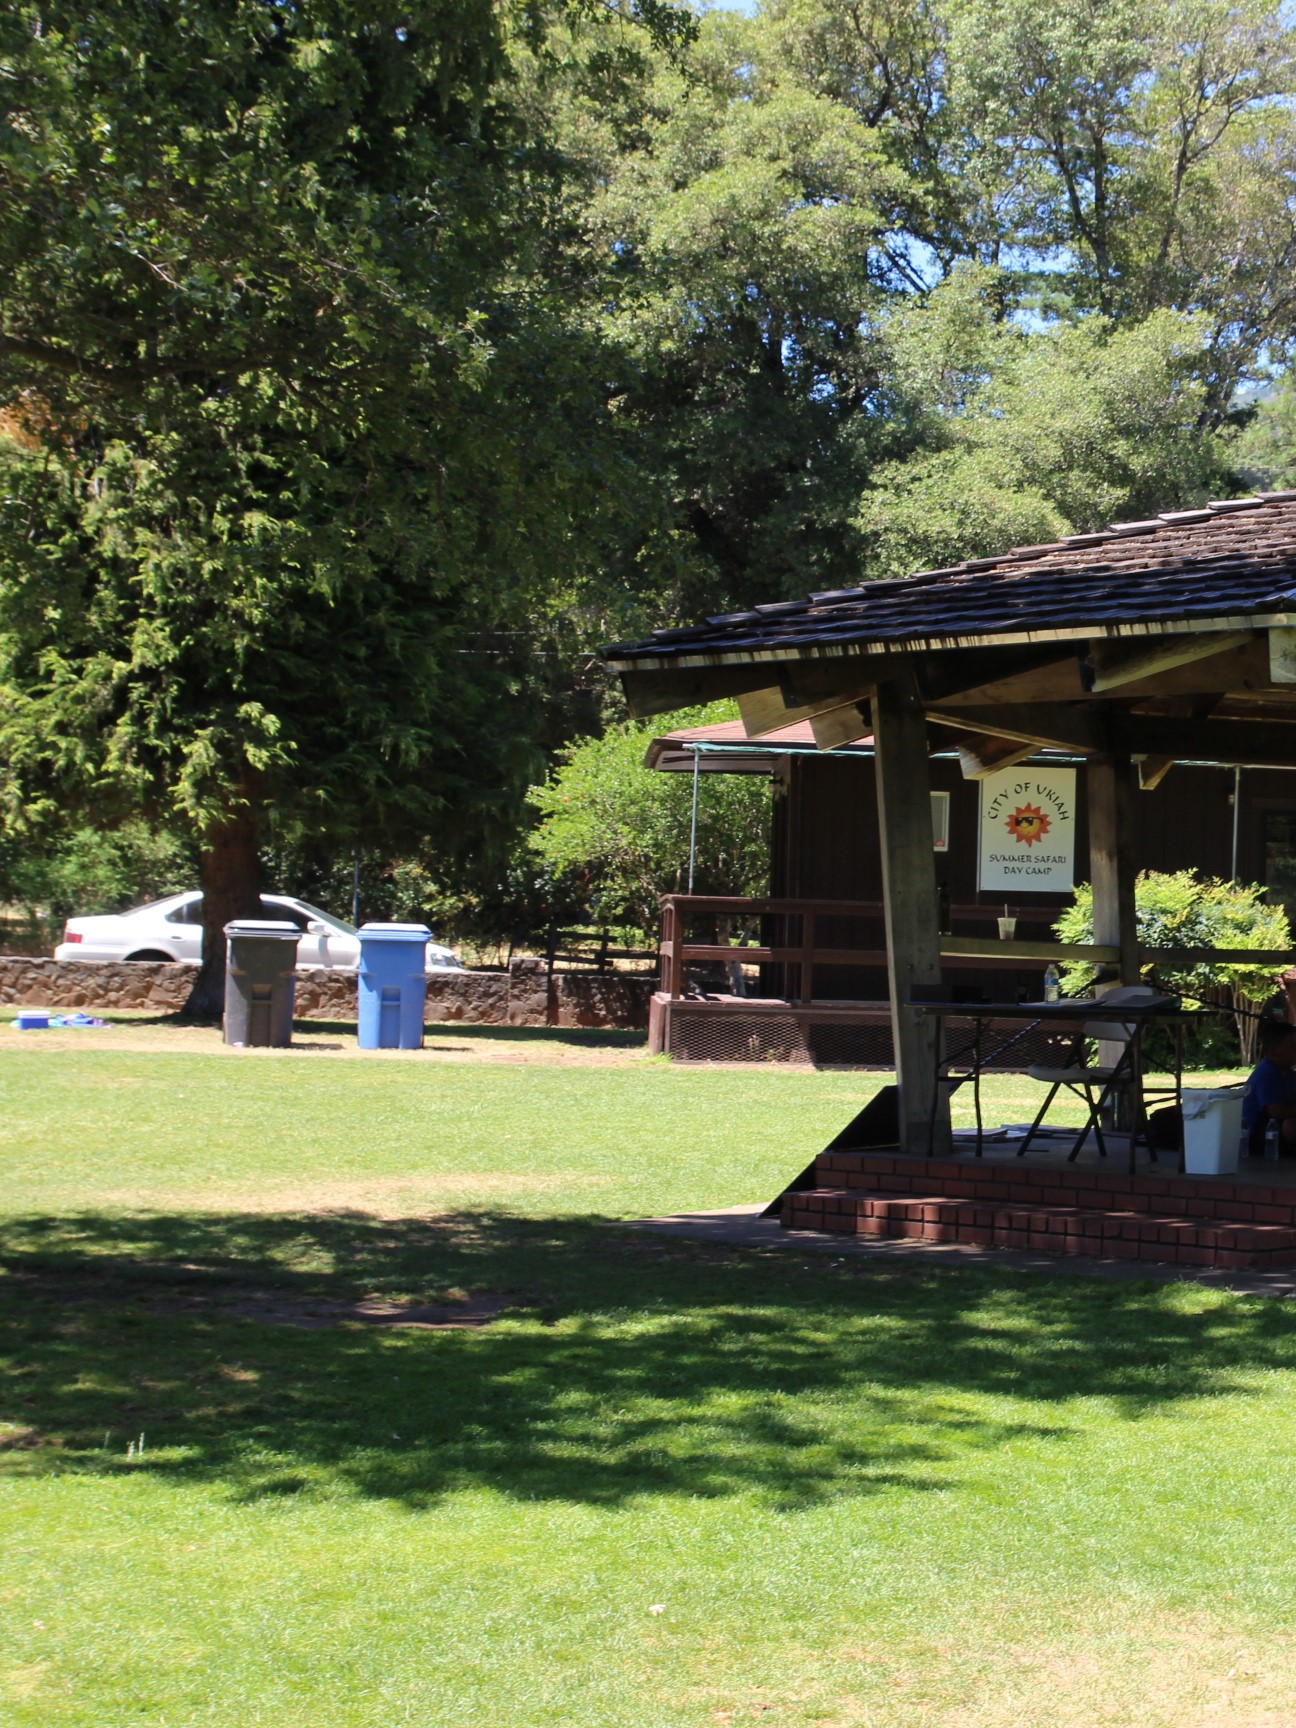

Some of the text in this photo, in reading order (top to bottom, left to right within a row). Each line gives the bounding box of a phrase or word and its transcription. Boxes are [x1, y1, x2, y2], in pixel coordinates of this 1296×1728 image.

[988, 782, 1070, 820] CITY OF UKIAH
[989, 854, 1066, 864] SUMMER SAFARI
[1003, 866, 1052, 875] DAY CAMP
